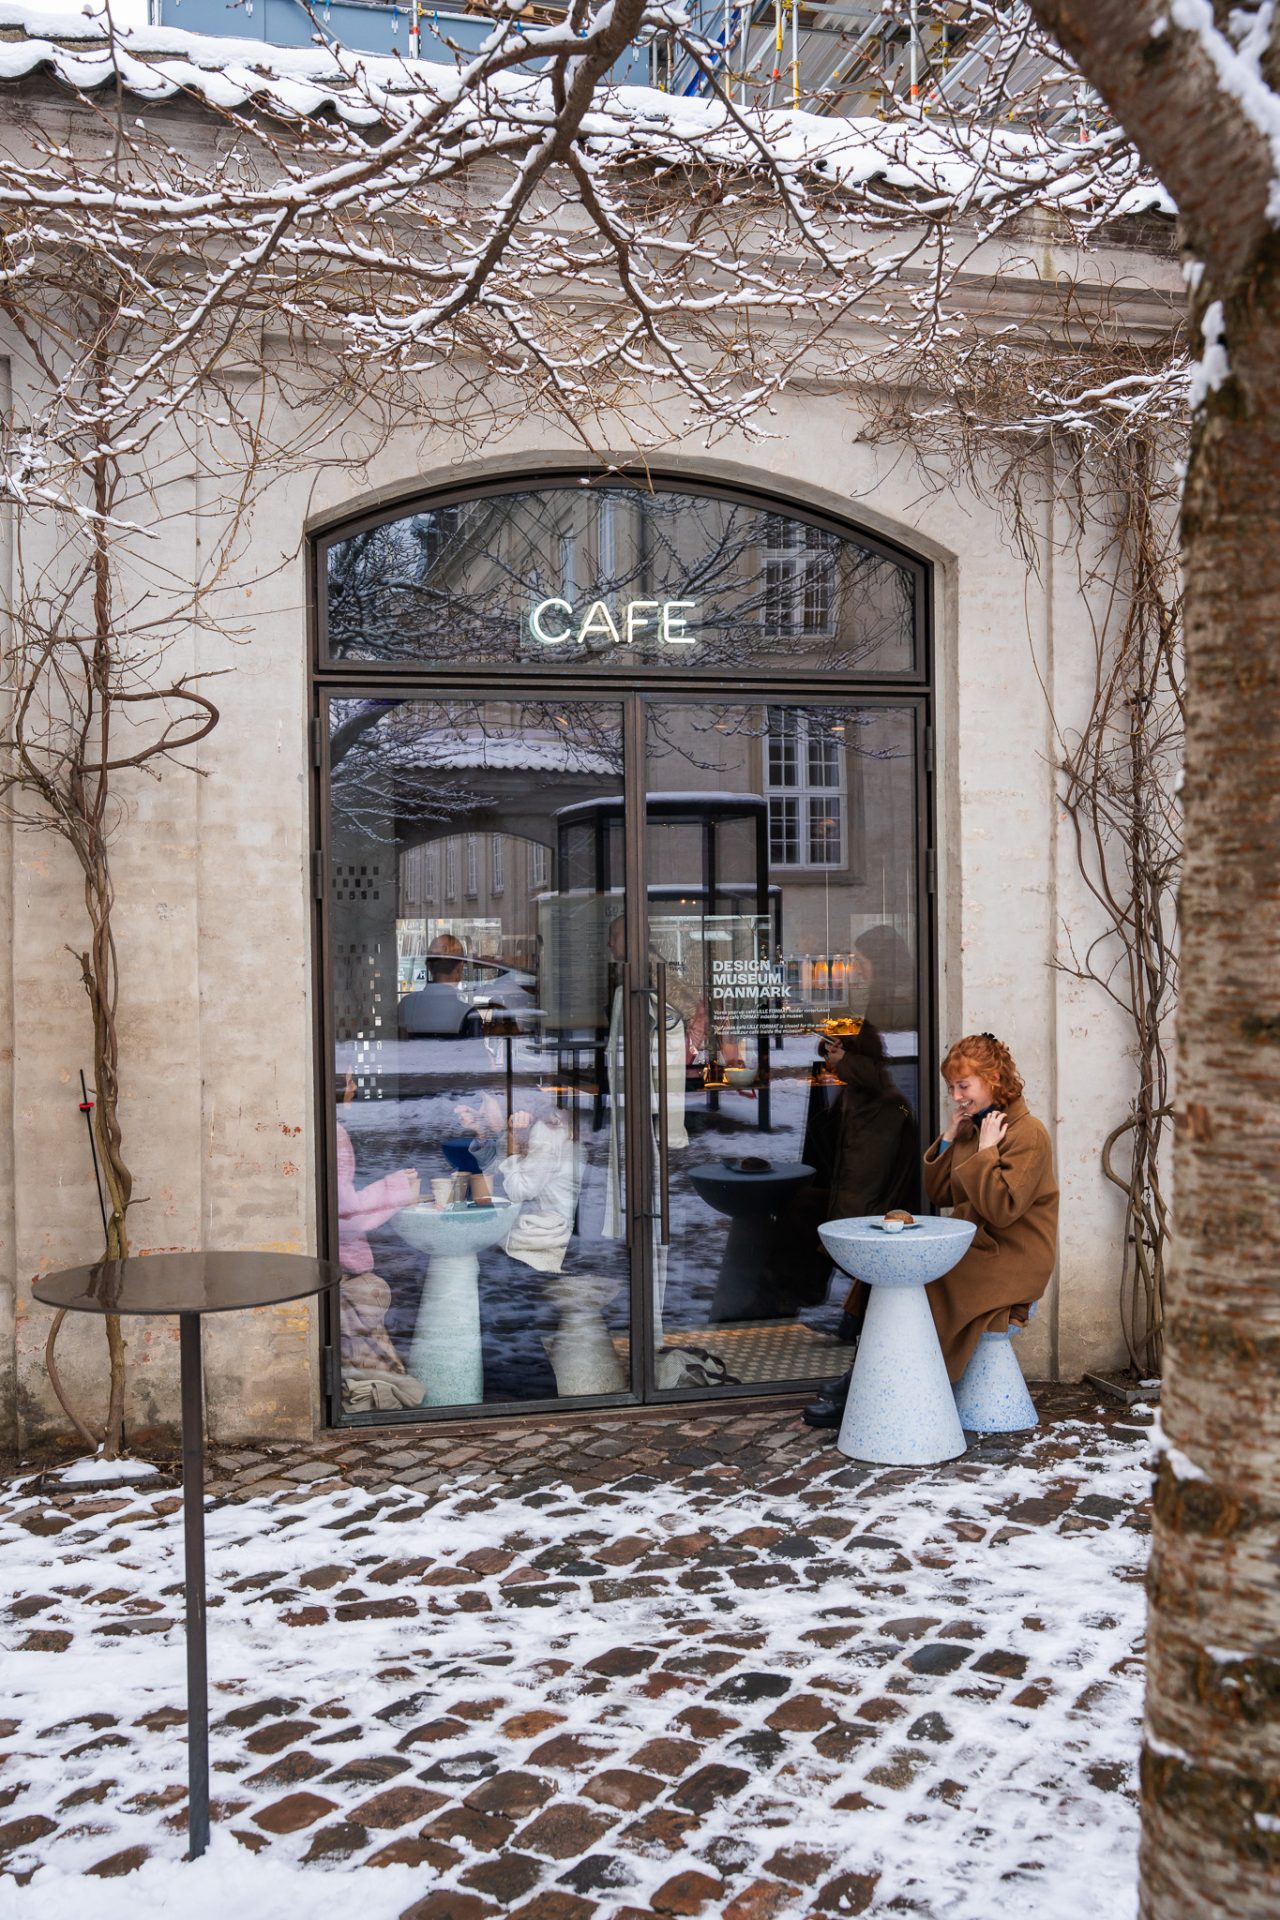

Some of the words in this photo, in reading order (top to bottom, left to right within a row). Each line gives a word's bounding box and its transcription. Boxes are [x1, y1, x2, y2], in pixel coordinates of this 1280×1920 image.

[533, 597, 695, 643] CAFE
[713, 960, 770, 971] DESIGN
[713, 973, 781, 985] MUSEUM
[713, 986, 791, 998] DANMARK
